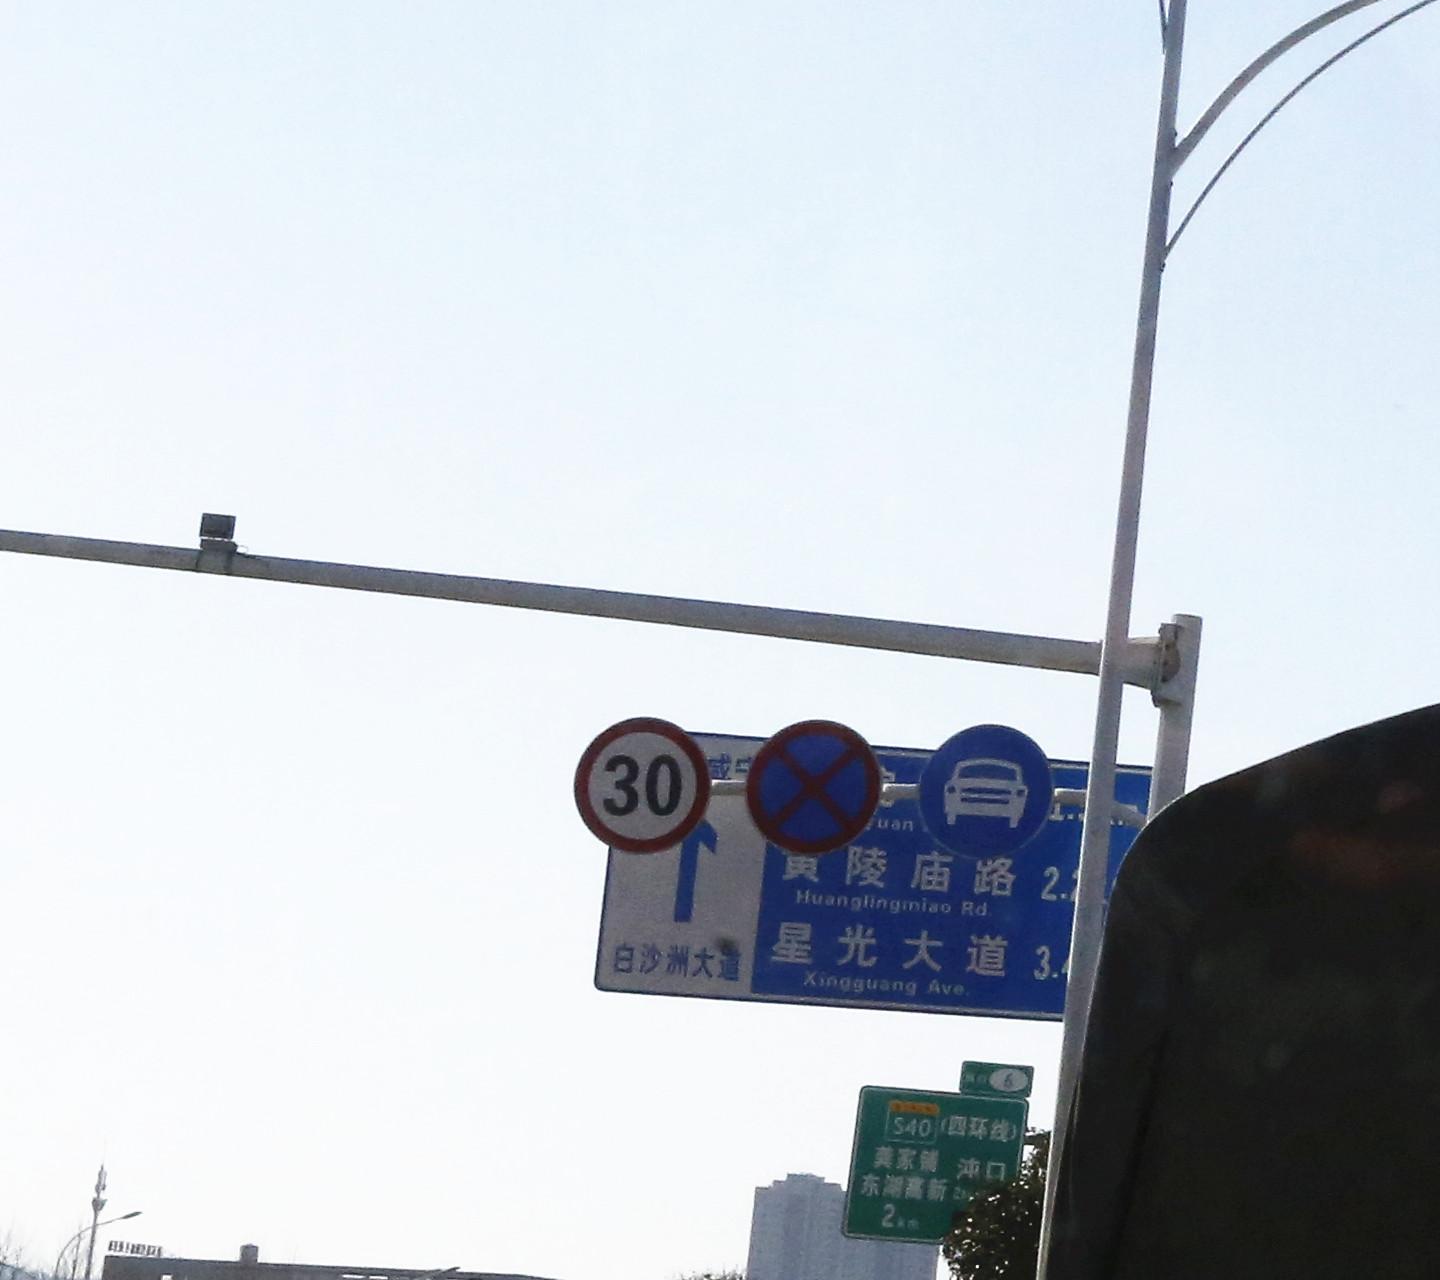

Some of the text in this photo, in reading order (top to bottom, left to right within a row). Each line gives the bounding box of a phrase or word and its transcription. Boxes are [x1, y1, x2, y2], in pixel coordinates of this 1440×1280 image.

[603, 754, 683, 818] 30
[781, 845, 1017, 897] 黄陵庙路
[796, 889, 952, 915] Huanglingmiao
[615, 944, 750, 985] 白沙洲大道
[771, 921, 1008, 978] 星光大道
[803, 971, 918, 996] Xingguang
[893, 1116, 932, 1137] S40
